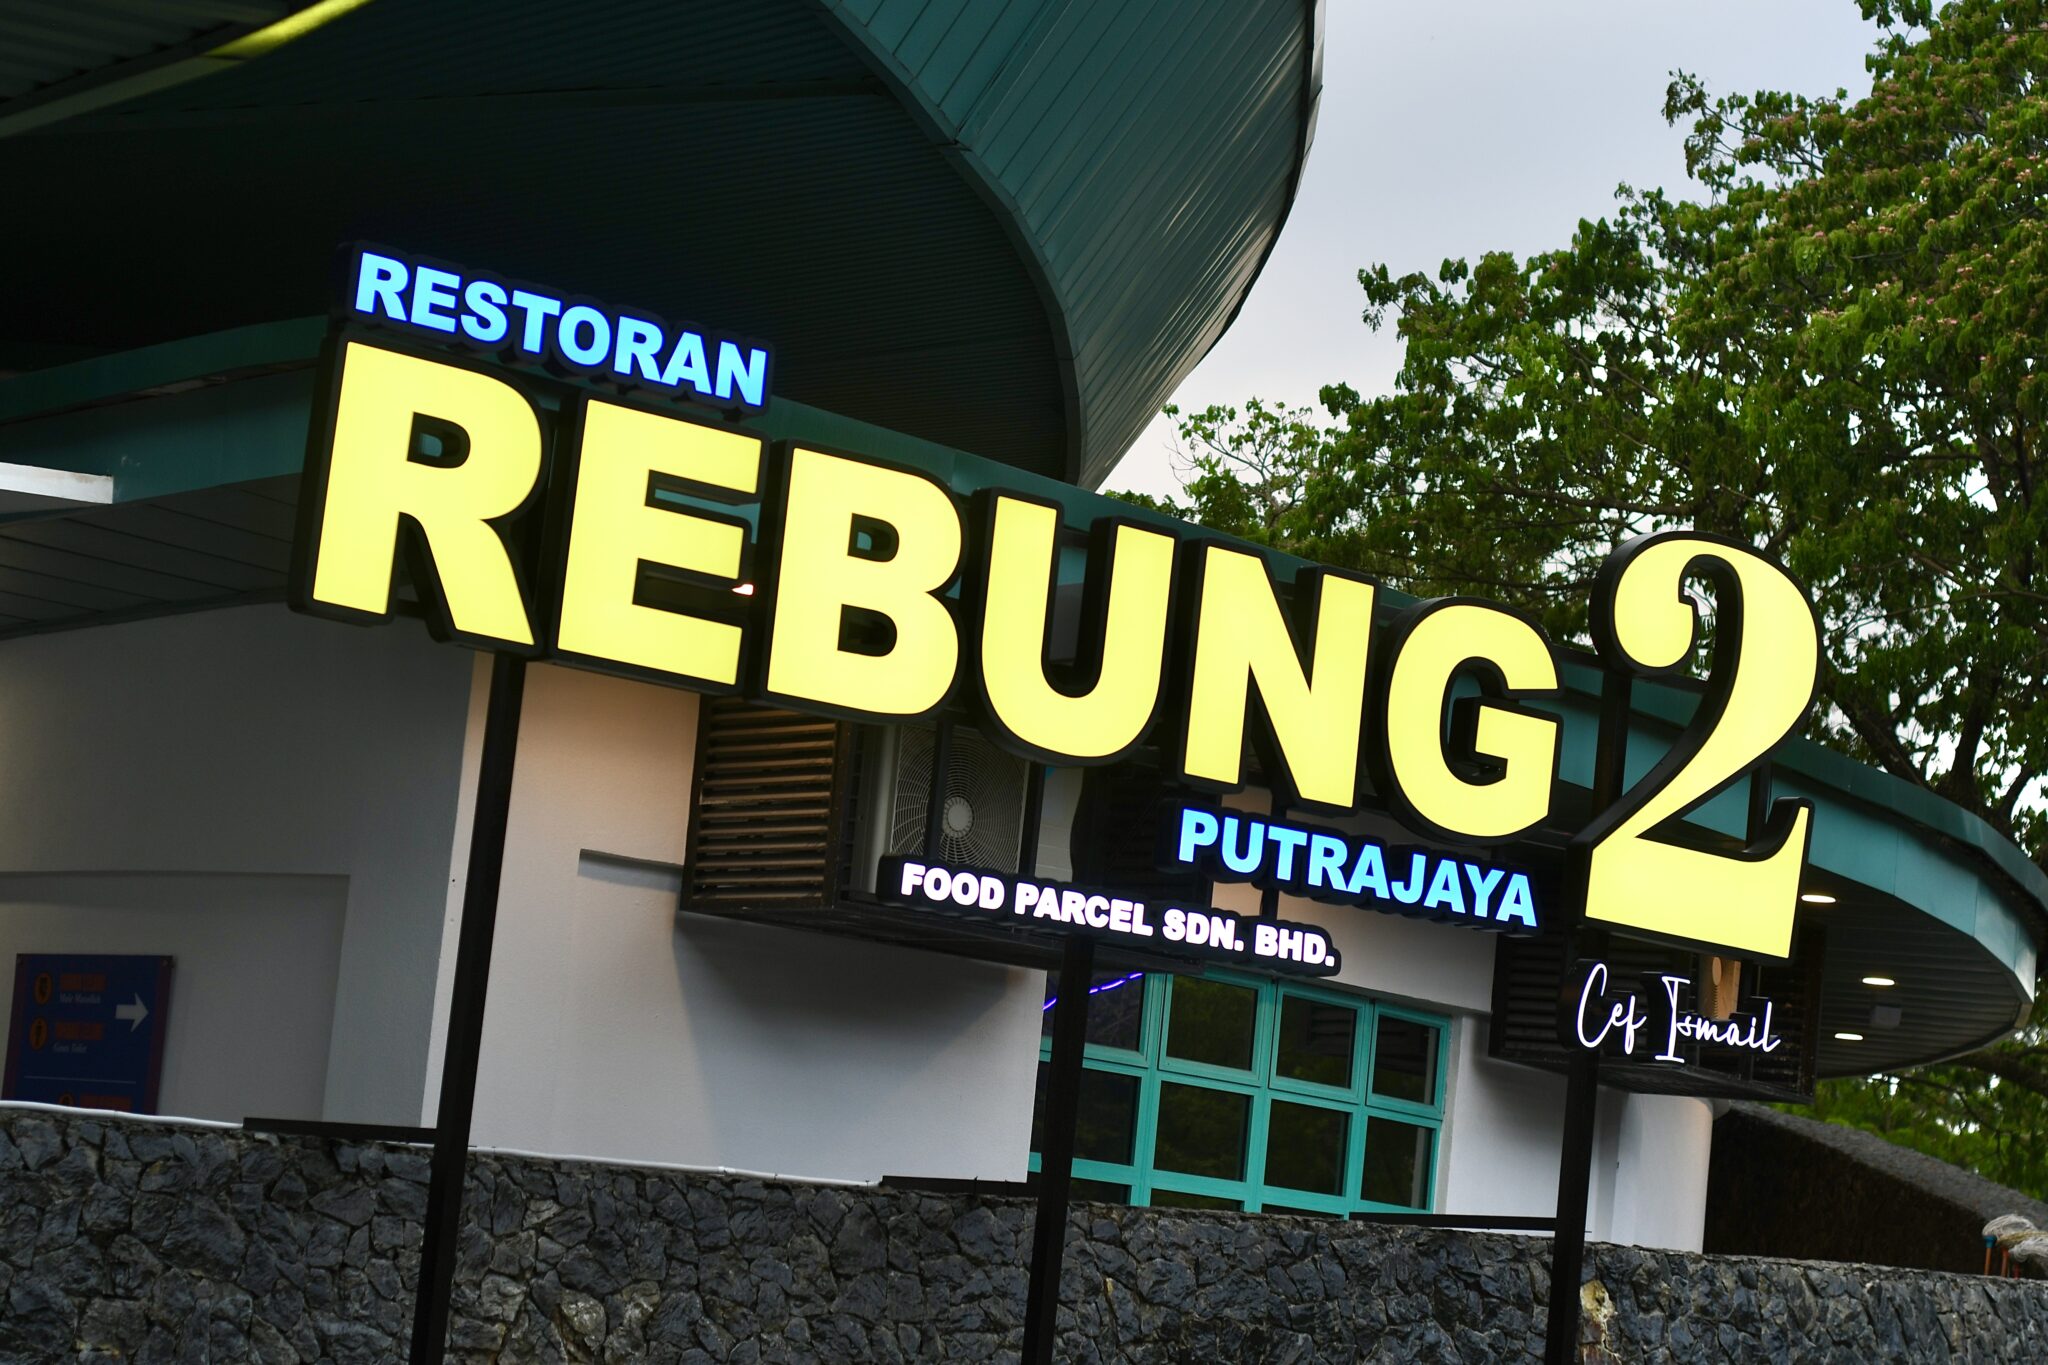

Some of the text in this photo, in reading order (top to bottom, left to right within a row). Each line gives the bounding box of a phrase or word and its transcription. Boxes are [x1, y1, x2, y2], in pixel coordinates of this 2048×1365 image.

[355, 252, 767, 406] RESTORAN
[313, 341, 1818, 958] REBUNG 2
[901, 862, 1336, 967] FOOD PARCEL SDN. BHD.
[1178, 808, 1537, 927] PUTRAJAYA
[1655, 976, 1782, 1063] Ismail
